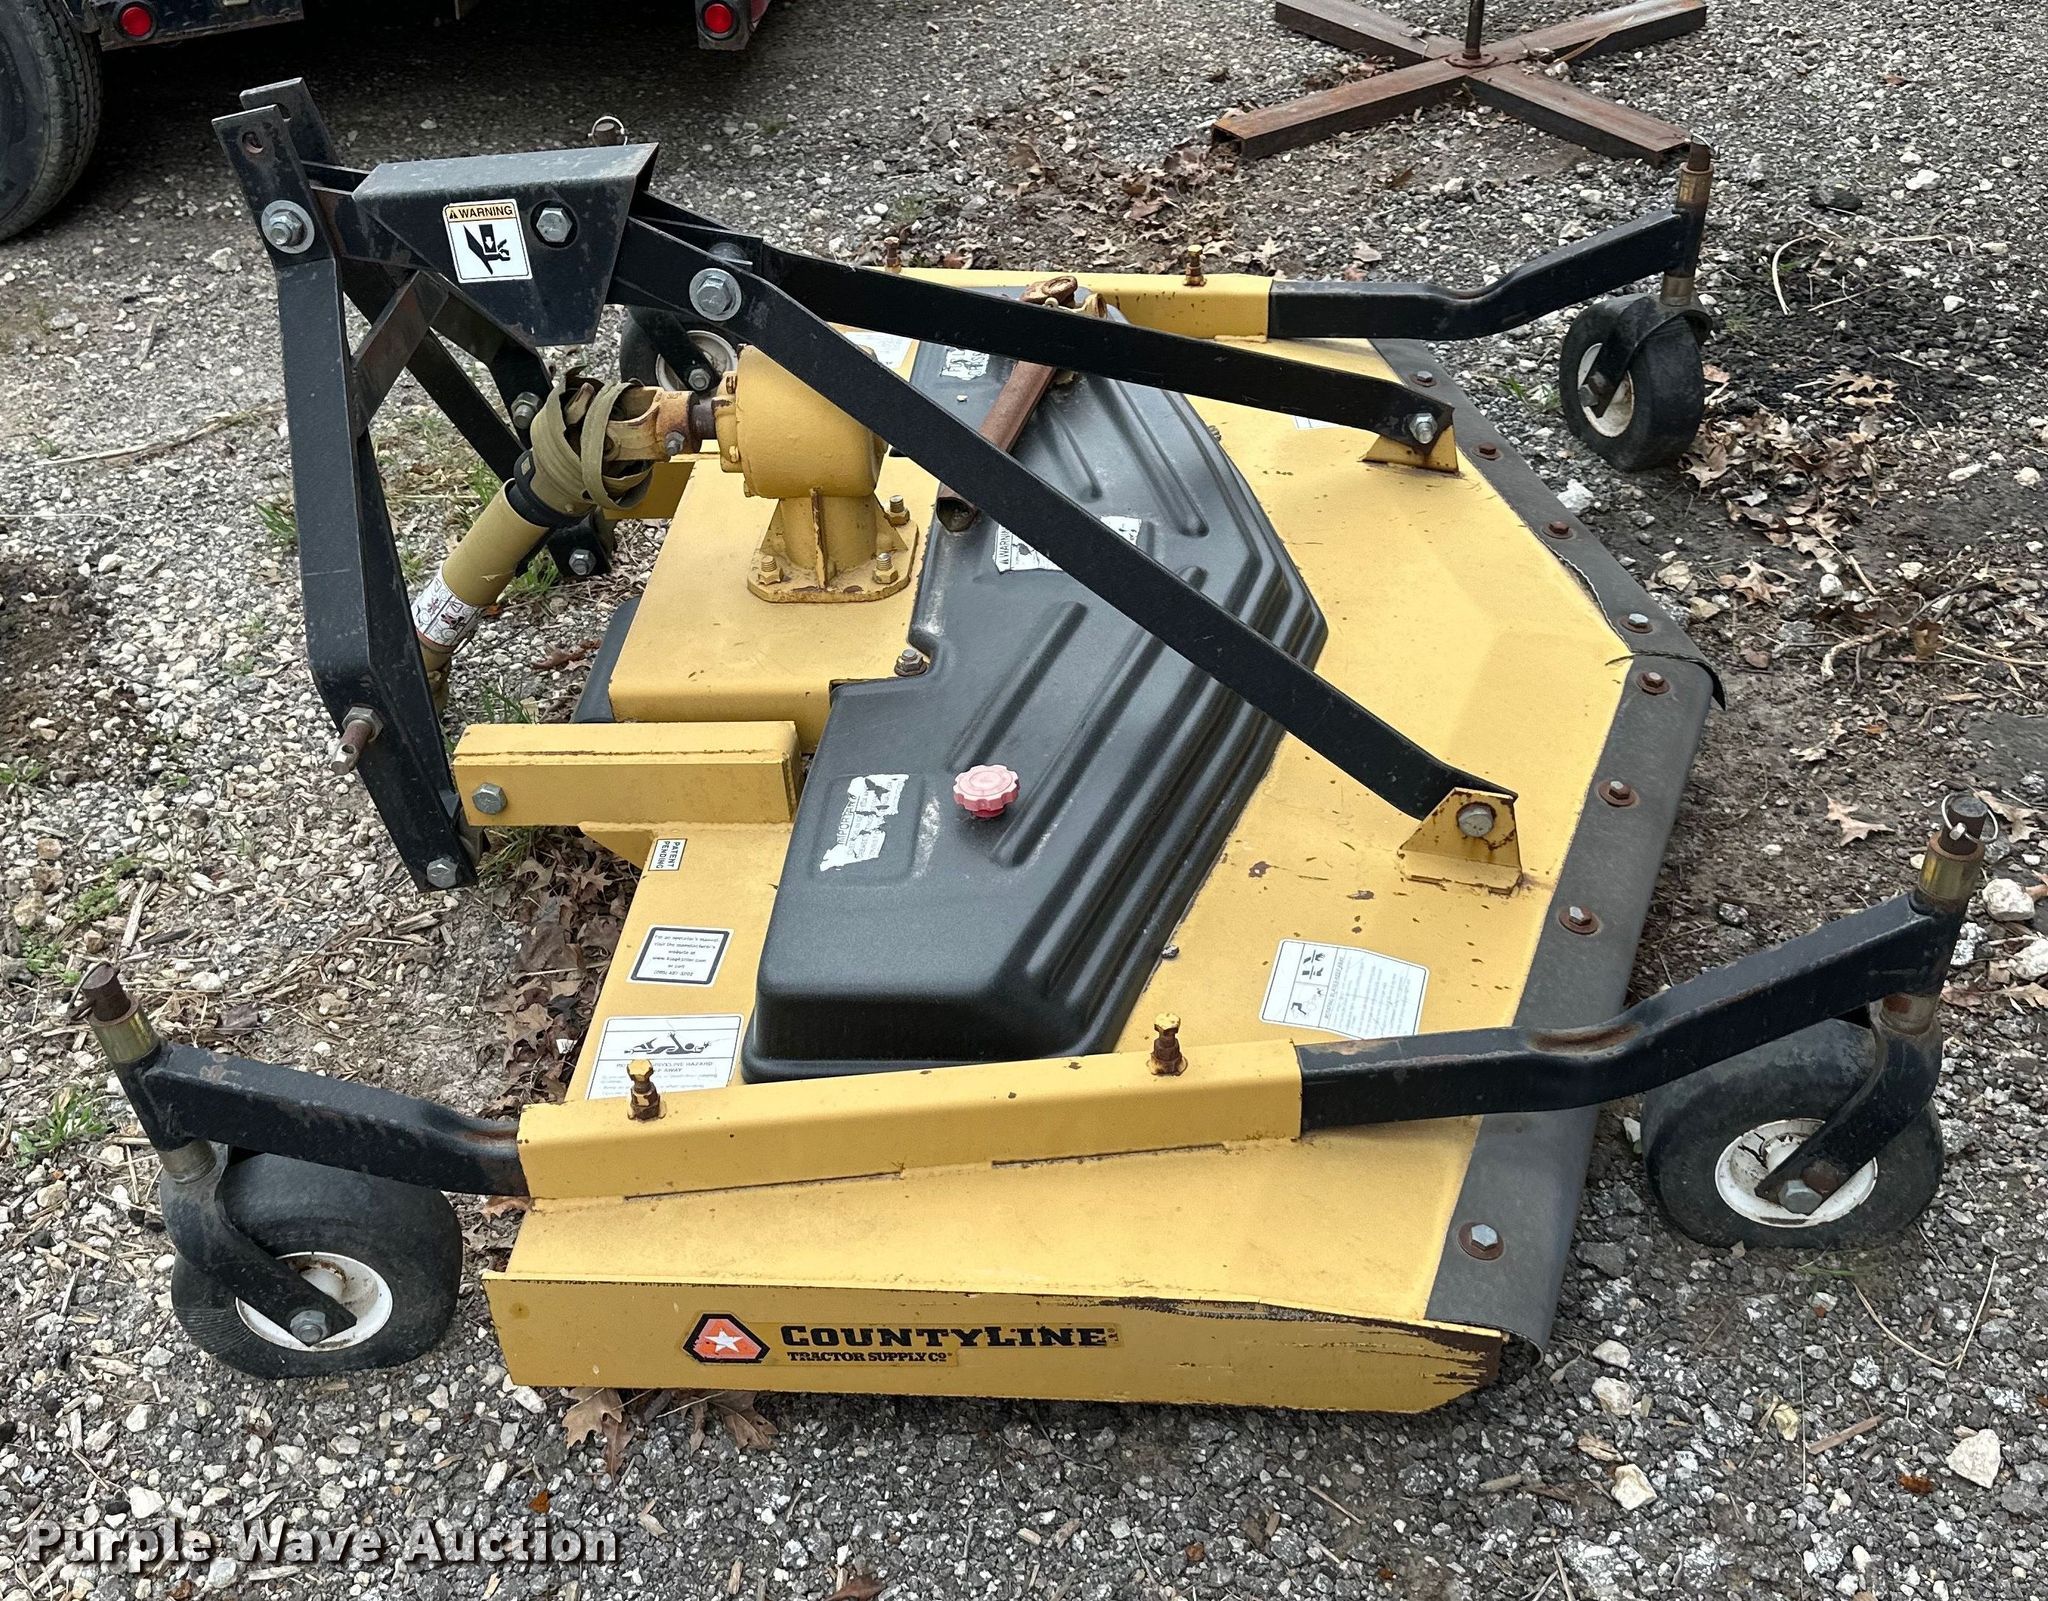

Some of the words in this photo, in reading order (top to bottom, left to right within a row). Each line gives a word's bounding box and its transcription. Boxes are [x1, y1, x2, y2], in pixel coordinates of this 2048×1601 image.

[458, 205, 513, 218] WARNING
[999, 528, 1010, 558] WARNIN
[656, 840, 671, 869] PENDING
[667, 841, 681, 868] PATENT
[780, 1325, 1107, 1347] COUNTYLINE
[786, 1351, 865, 1362] TRACTOR
[867, 1351, 926, 1362] SUPPLY
